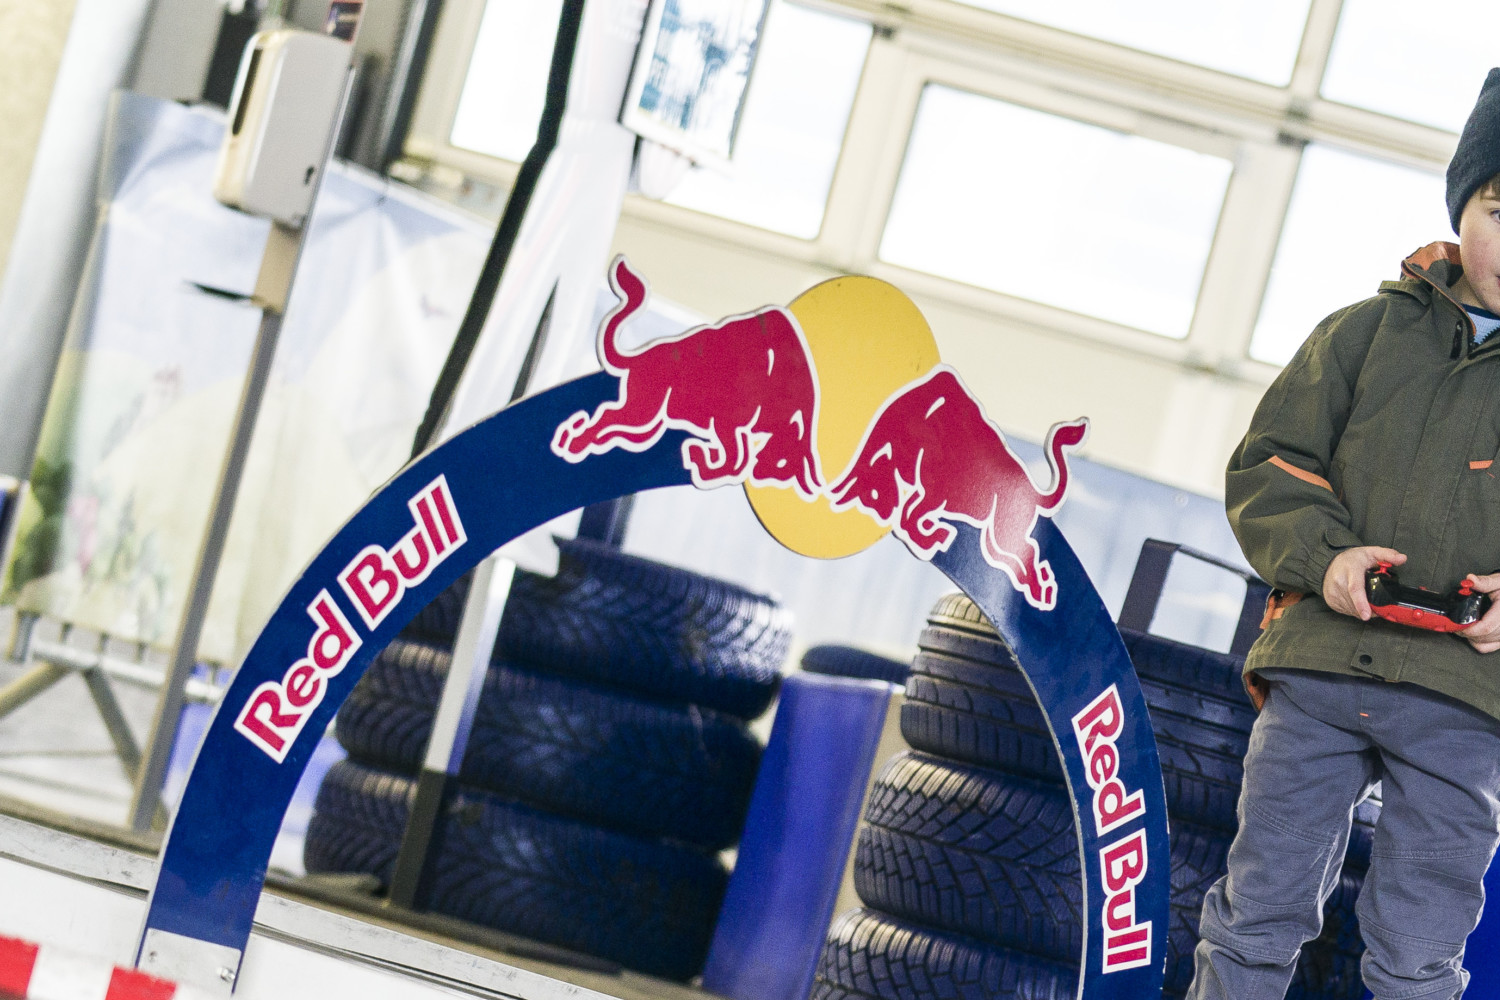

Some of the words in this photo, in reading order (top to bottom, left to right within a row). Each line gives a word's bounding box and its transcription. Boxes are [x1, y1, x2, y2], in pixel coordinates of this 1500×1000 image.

[239, 593, 360, 759] Red
[342, 480, 463, 626] Bull
[1074, 687, 1145, 833] Red
[1101, 831, 1150, 970] Bull
